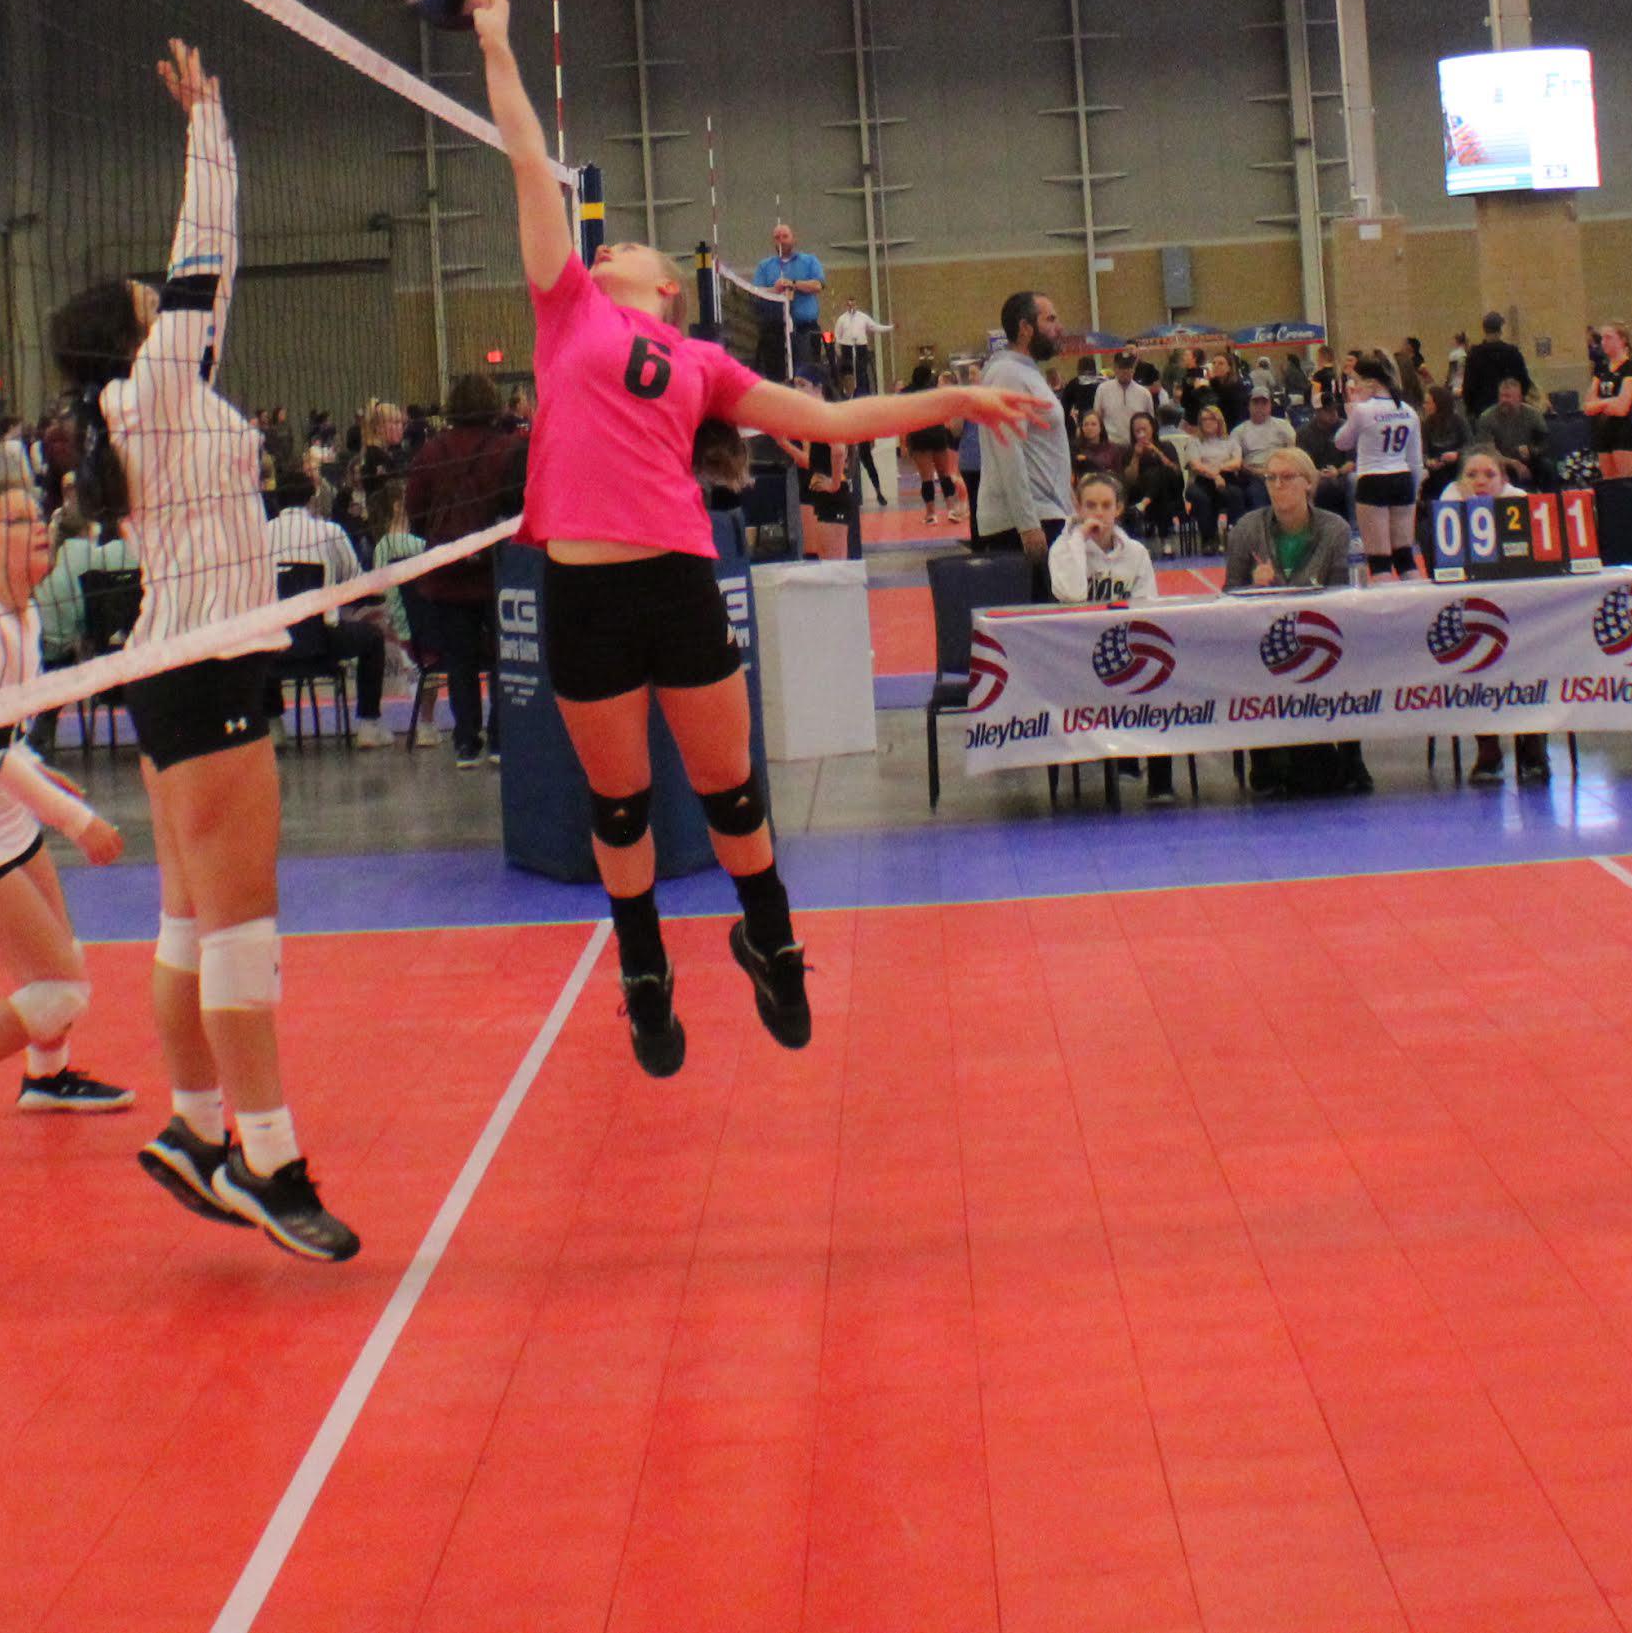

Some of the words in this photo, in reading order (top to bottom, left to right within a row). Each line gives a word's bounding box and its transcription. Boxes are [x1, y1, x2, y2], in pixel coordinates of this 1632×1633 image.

[624, 336, 671, 400] 6
[1381, 424, 1410, 453] 19
[1506, 506, 1521, 530] 2
